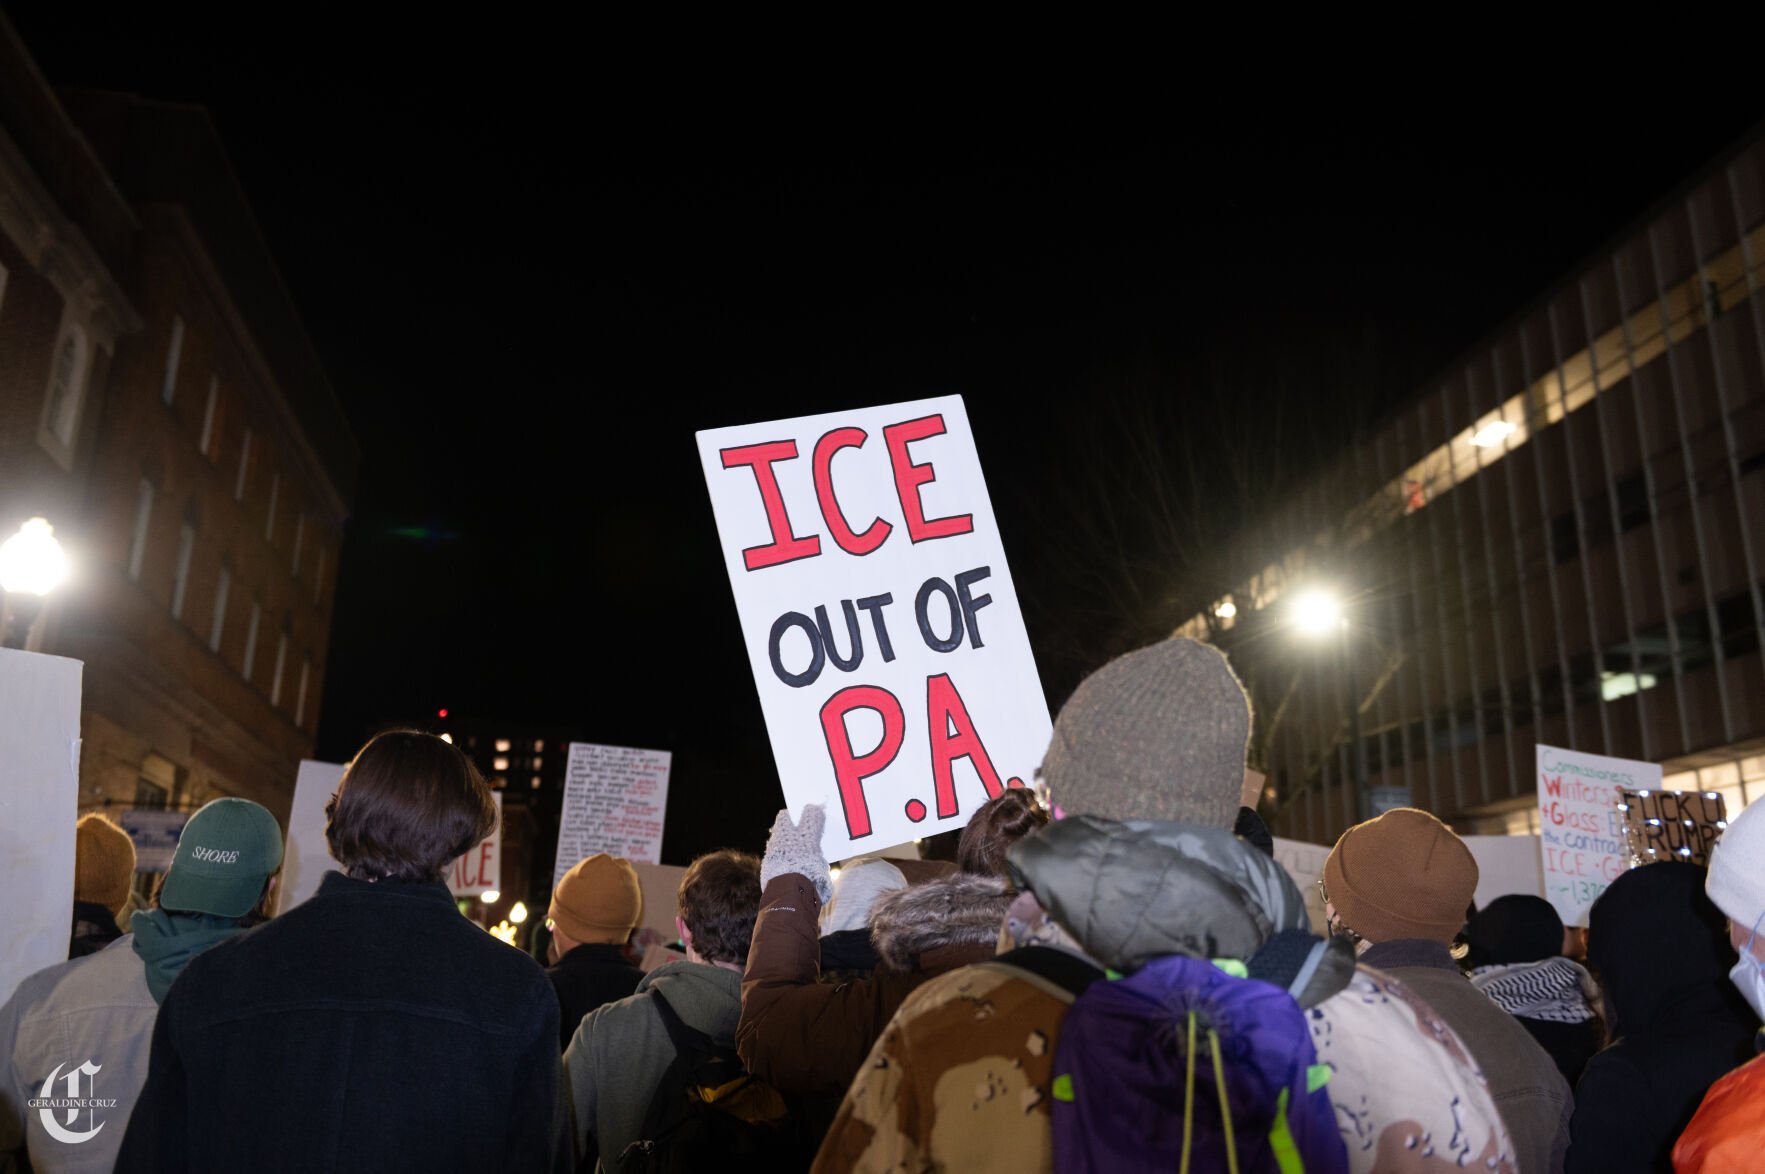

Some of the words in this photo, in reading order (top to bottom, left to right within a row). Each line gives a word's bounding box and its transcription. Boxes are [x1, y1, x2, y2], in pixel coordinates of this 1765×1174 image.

[720, 413, 974, 572] ICE
[769, 592, 896, 688] OUT
[915, 566, 993, 653] OF
[1623, 791, 1697, 823] FUCK
[1699, 793, 1723, 824] U
[192, 846, 240, 863] SHORE
[1564, 832, 1626, 857] contrac
[455, 842, 494, 889] ICE
[1546, 848, 1588, 877] ICE
